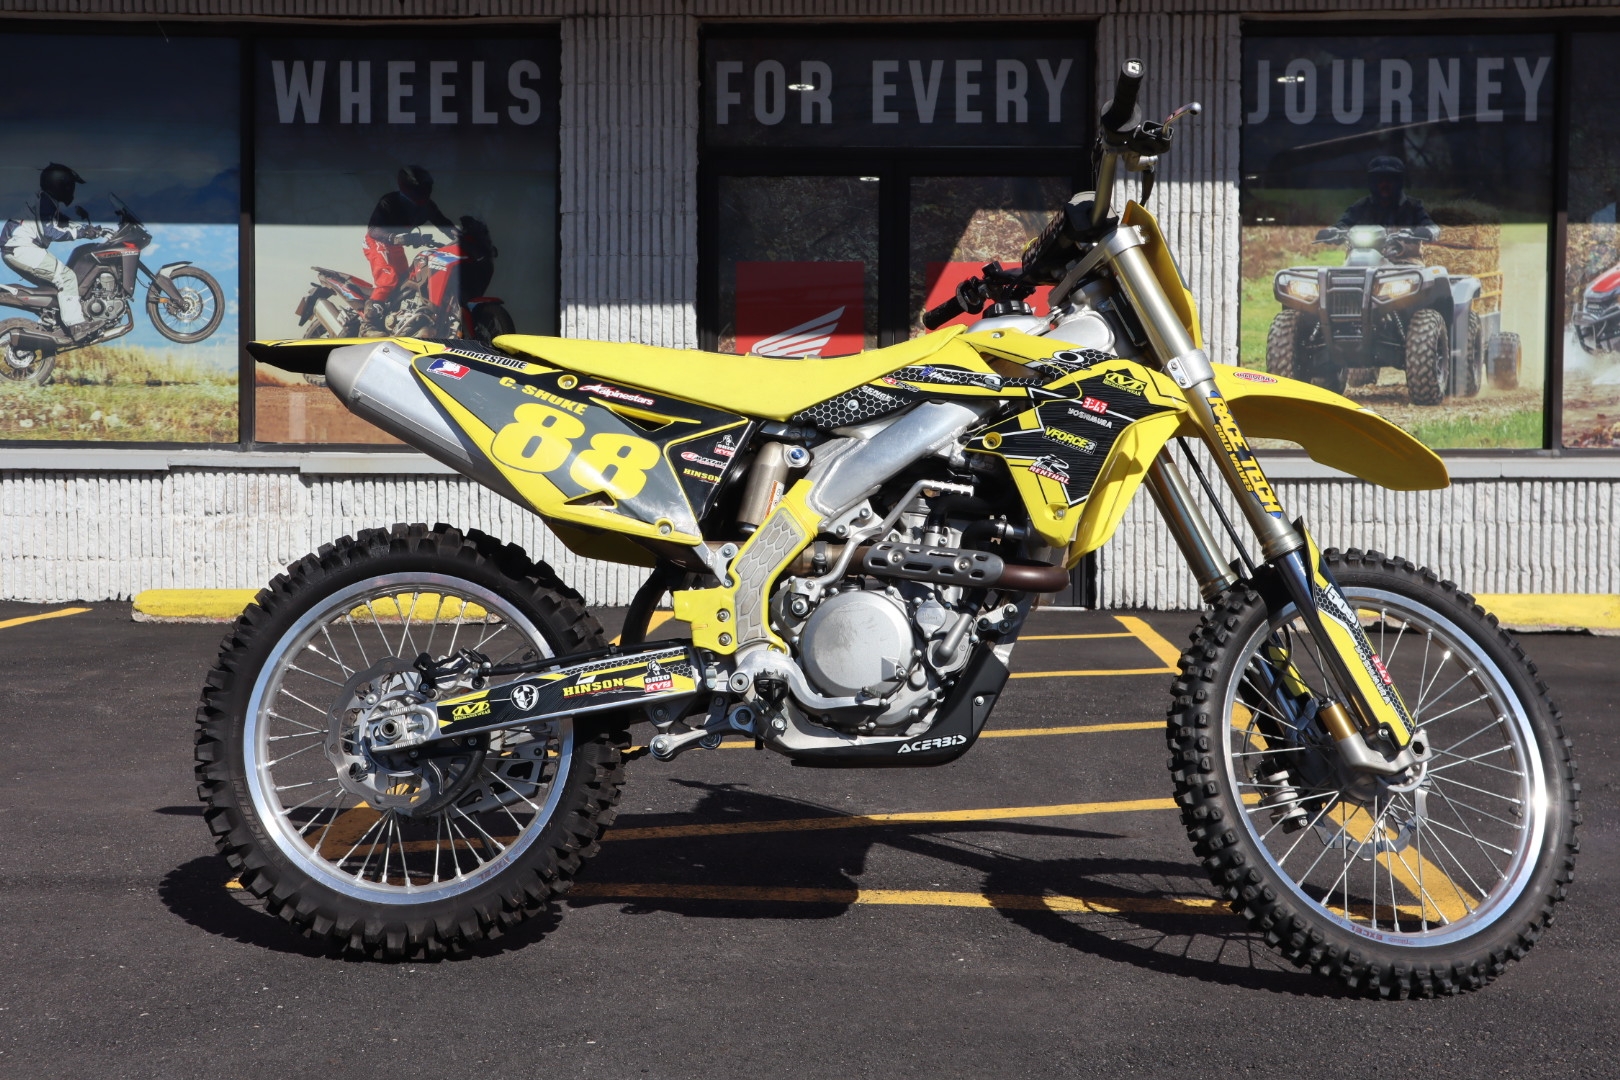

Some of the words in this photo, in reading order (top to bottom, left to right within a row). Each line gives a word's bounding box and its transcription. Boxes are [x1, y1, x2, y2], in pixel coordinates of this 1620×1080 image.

[271, 59, 541, 126] WHEELS
[716, 59, 833, 126] FOR
[872, 59, 1074, 124] EVERY
[1247, 57, 1551, 125] JOURNEY
[499, 377, 517, 390] C.
[521, 384, 589, 415] SHUKE
[599, 386, 655, 405] alpinestars
[1067, 407, 1113, 429] YOSHIMURA
[491, 403, 661, 500] 88
[1206, 397, 1250, 452] RACE
[1240, 455, 1283, 513] TECH
[1213, 424, 1234, 452] GOLD
[1229, 453, 1254, 492] VALVES
[683, 468, 721, 483] HINSON
[1029, 466, 1070, 485] RENTHAL
[645, 674, 671, 685] enzo
[646, 681, 671, 692] KYB
[1354, 645, 1391, 706] YOSHIMURA
[562, 678, 625, 697] HINSON
[897, 734, 967, 754] ACERBIS
[1349, 924, 1383, 941] EXCEL
